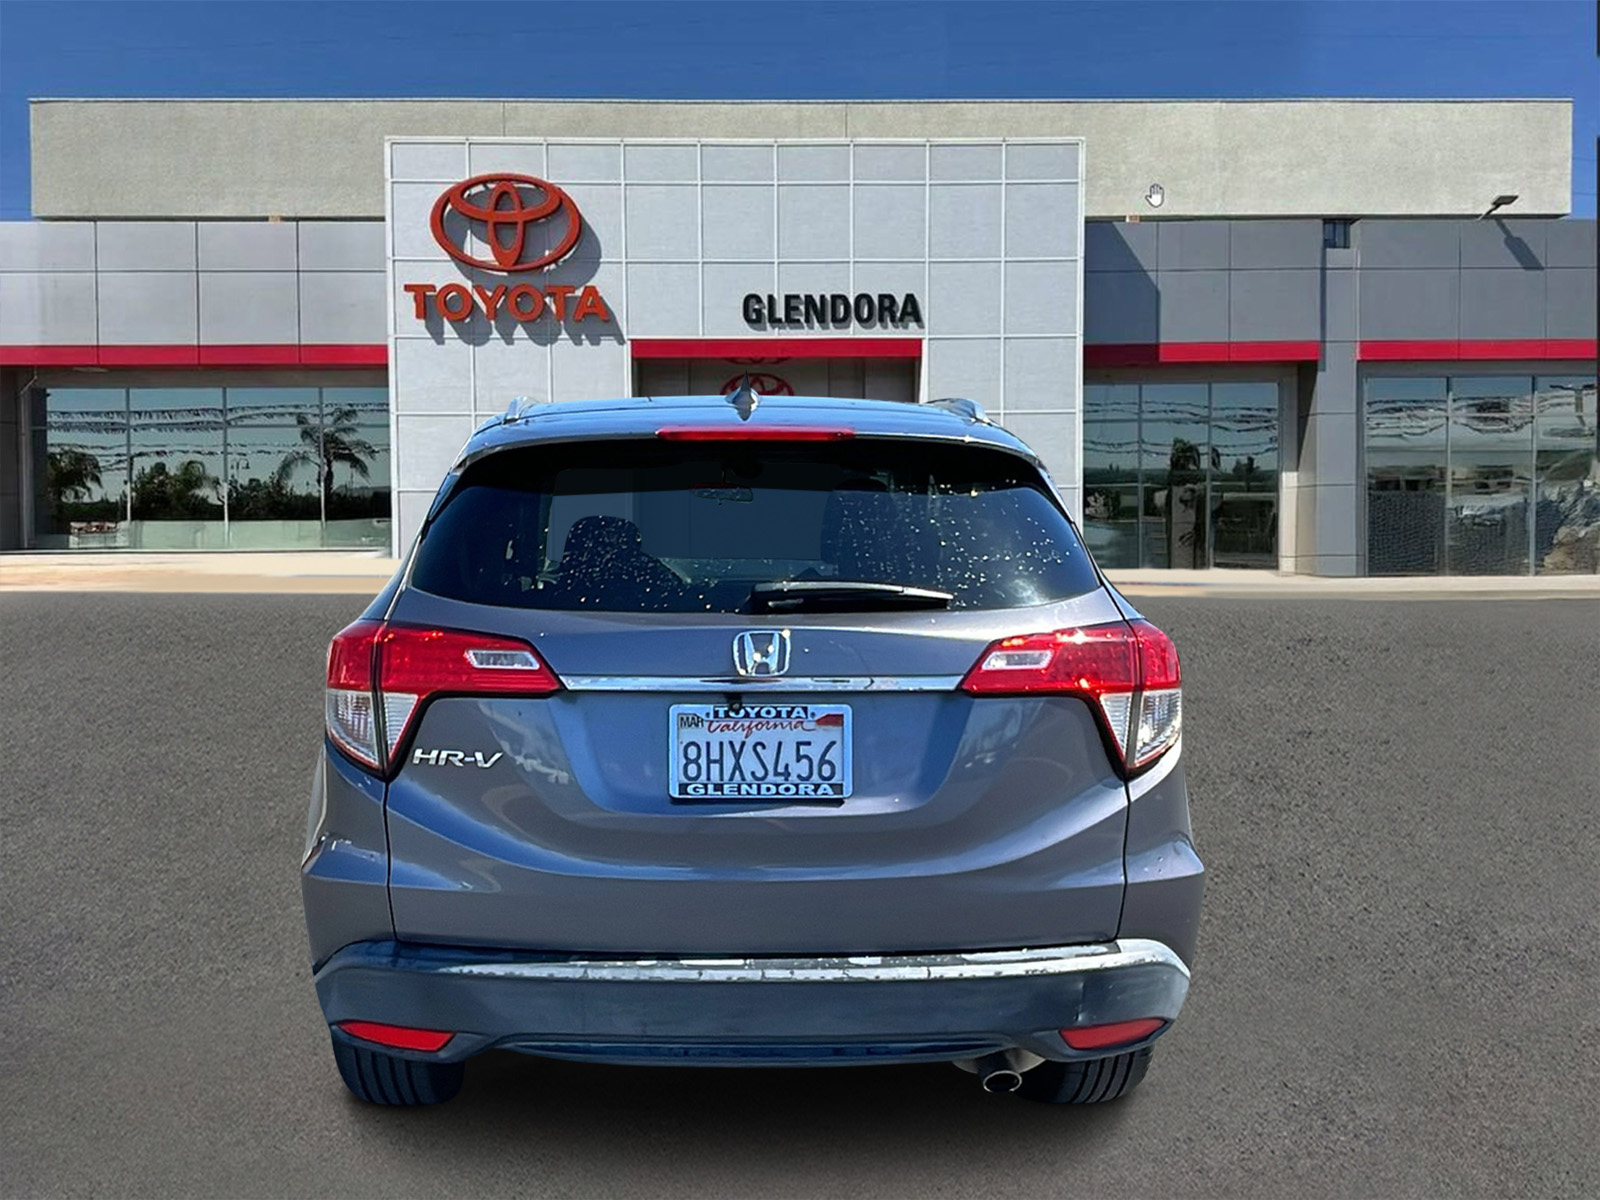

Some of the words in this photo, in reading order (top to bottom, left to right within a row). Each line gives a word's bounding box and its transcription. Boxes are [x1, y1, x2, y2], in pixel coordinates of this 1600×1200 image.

[404, 283, 611, 323] TOYOTA
[743, 293, 923, 325] GLENDORA
[714, 706, 806, 718] TOYOTA
[707, 720, 816, 739] California
[412, 748, 503, 768] HR-V
[682, 740, 837, 782] 8HXS456
[686, 783, 835, 796] GLENDORA
